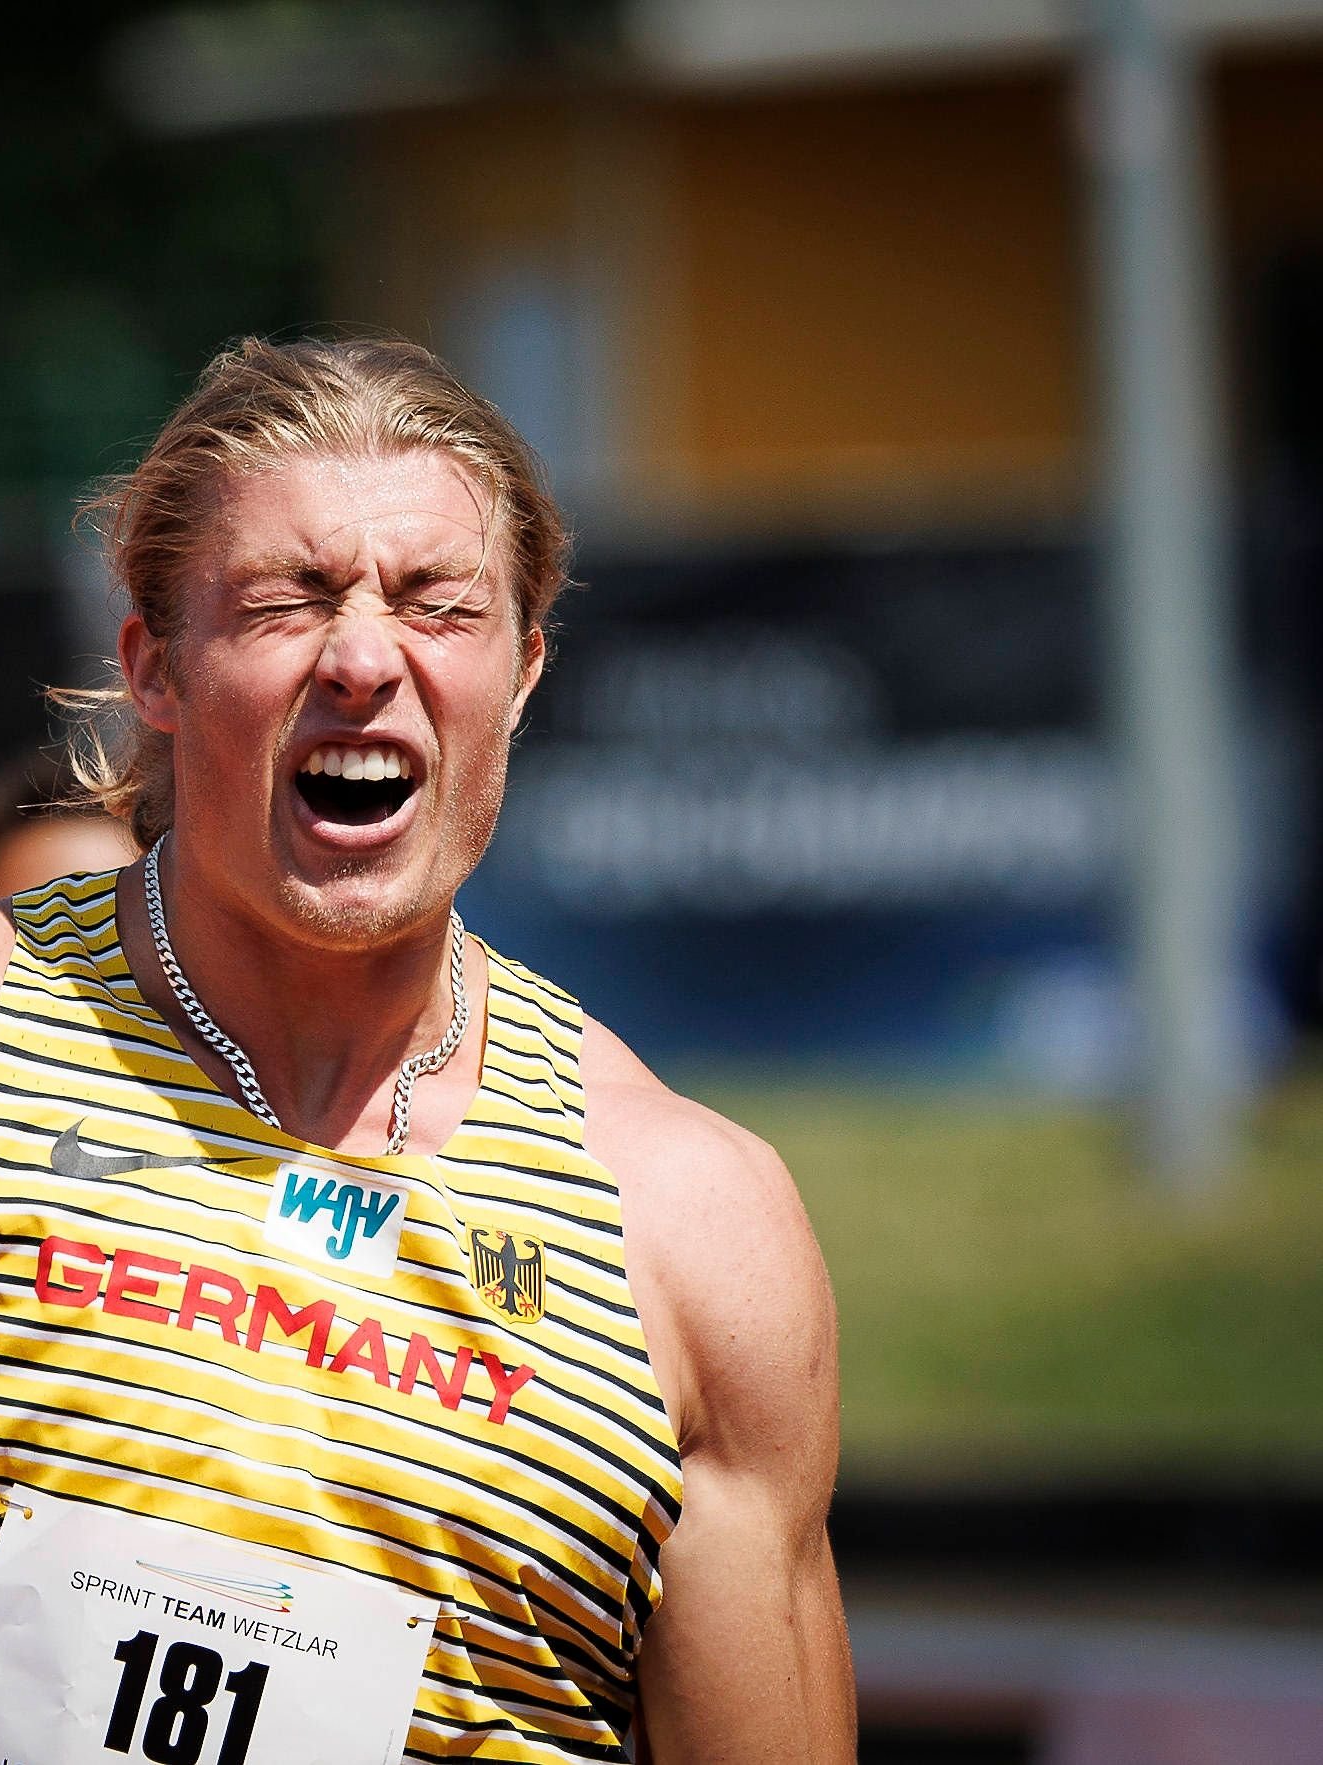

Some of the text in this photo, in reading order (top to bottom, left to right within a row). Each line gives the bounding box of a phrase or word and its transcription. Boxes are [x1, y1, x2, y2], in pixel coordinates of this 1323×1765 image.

[33, 1235, 537, 1425] GERMANY
[70, 1570, 340, 1660] SPRINT TEAM WETZLAR
[103, 1629, 270, 1765] 181
